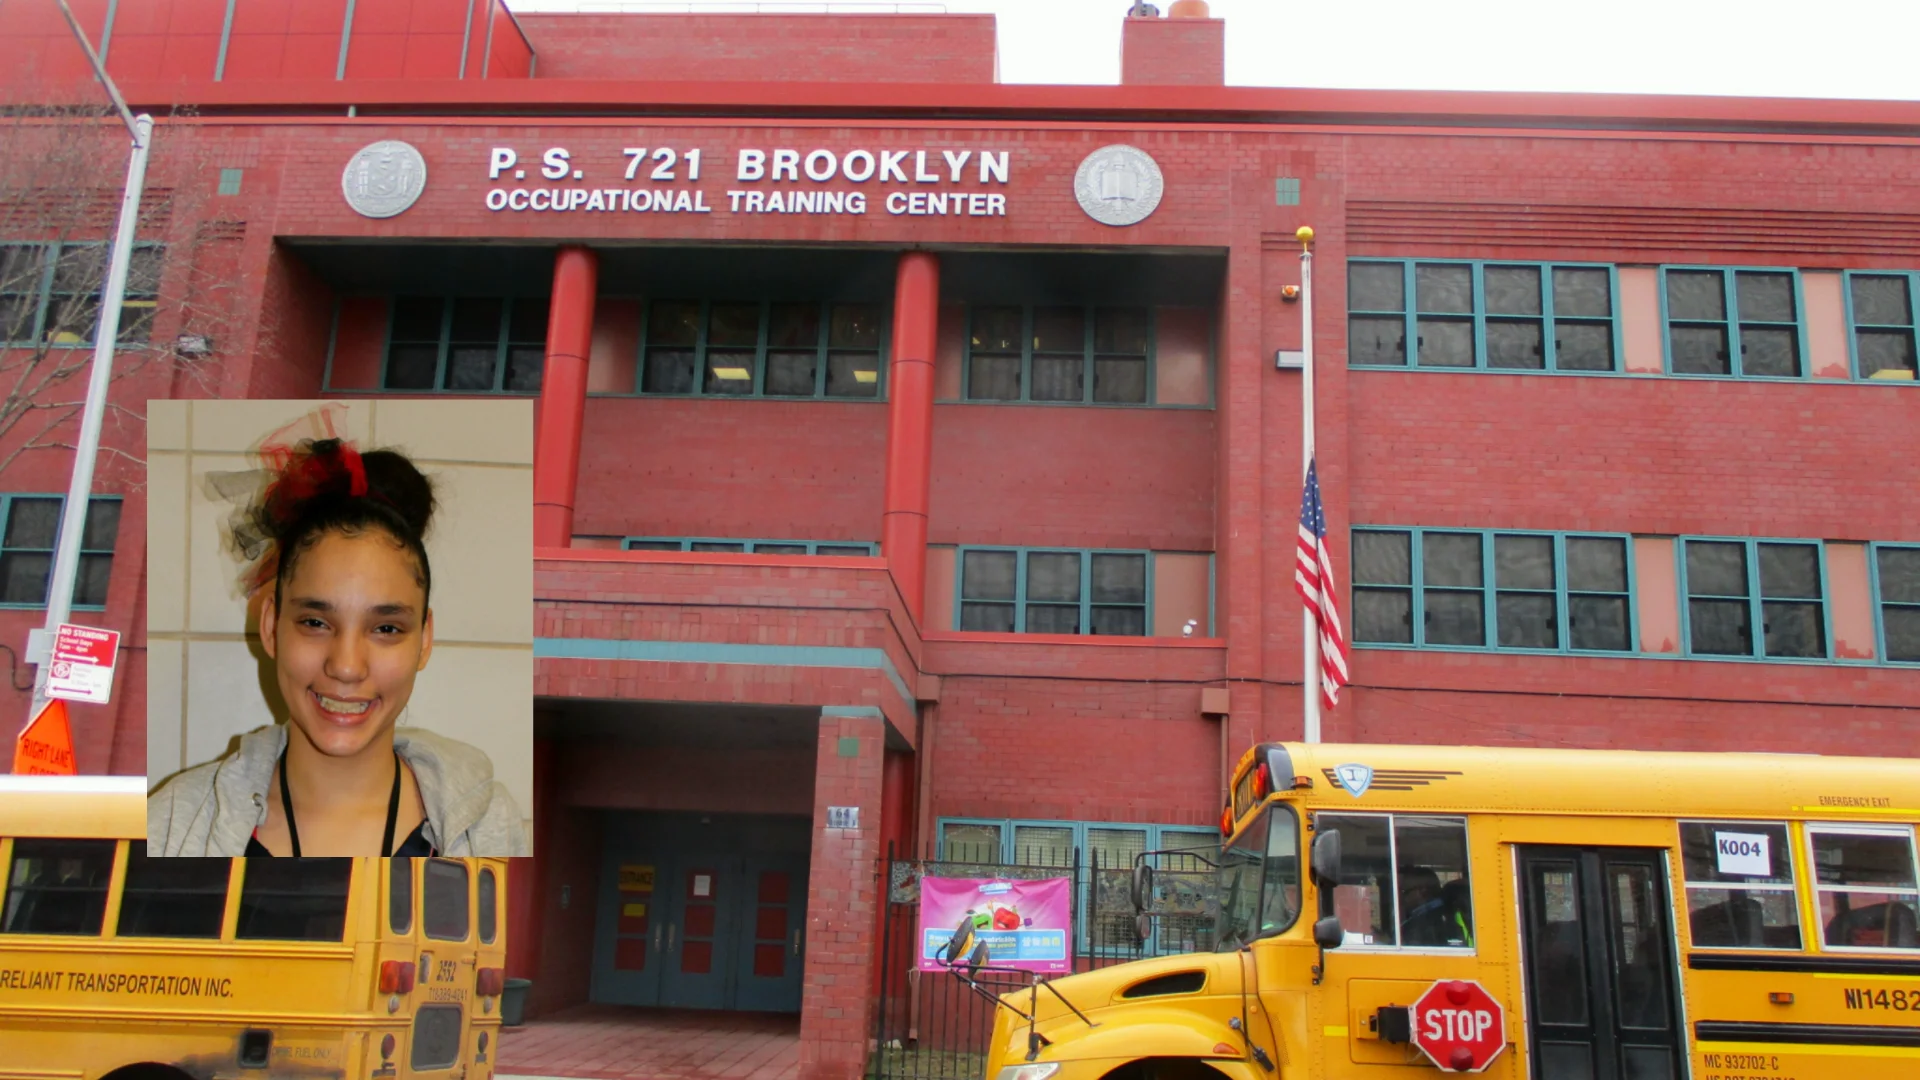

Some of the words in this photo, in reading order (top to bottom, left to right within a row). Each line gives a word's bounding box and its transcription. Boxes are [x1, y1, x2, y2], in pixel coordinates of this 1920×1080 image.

[489, 147, 526, 180] P.
[541, 147, 584, 180] S.
[623, 147, 701, 180] 721
[737, 148, 1009, 183] BROOKLYN
[486, 188, 711, 212] OCCUPATIONAL
[727, 190, 867, 214] TRAINING
[886, 192, 1006, 215] CENTER
[60, 635, 79, 645] School
[61, 628, 72, 636] NO
[73, 629, 110, 641] STANDING
[22, 738, 50, 761] RIGHT
[50, 745, 71, 769] LANE
[1818, 795, 1870, 808] EMERGENCY
[1872, 797, 1891, 808] EXIT
[1718, 838, 1762, 857] K004
[0, 969, 64, 991] RELIANT
[67, 972, 201, 997] TRANSPORTATION
[204, 977, 234, 998] INC.
[1423, 1009, 1492, 1042] STOP
[1704, 1054, 1722, 1069] MC
[1724, 1054, 1780, 1071] 932702-C
